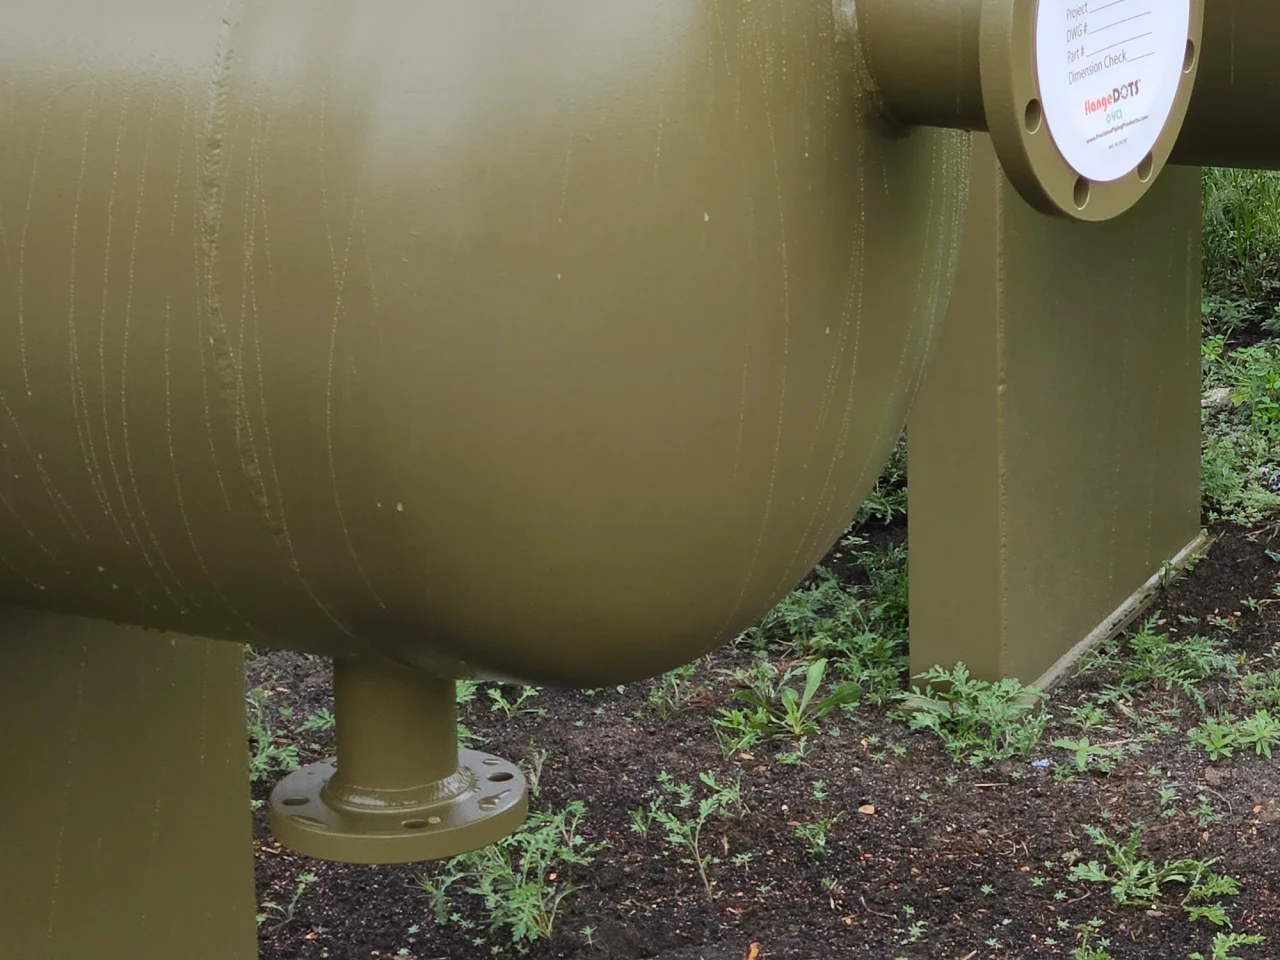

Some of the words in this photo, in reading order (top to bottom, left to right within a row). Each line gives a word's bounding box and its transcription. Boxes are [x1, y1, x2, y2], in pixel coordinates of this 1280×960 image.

[1066, 1, 1088, 21] Project
[1066, 23, 1082, 43] DWG
[1083, 21, 1088, 35] #
[1067, 48, 1079, 64] Part
[1080, 44, 1085, 57] #
[1068, 60, 1103, 85] Dimension
[1103, 48, 1128, 69] Check
